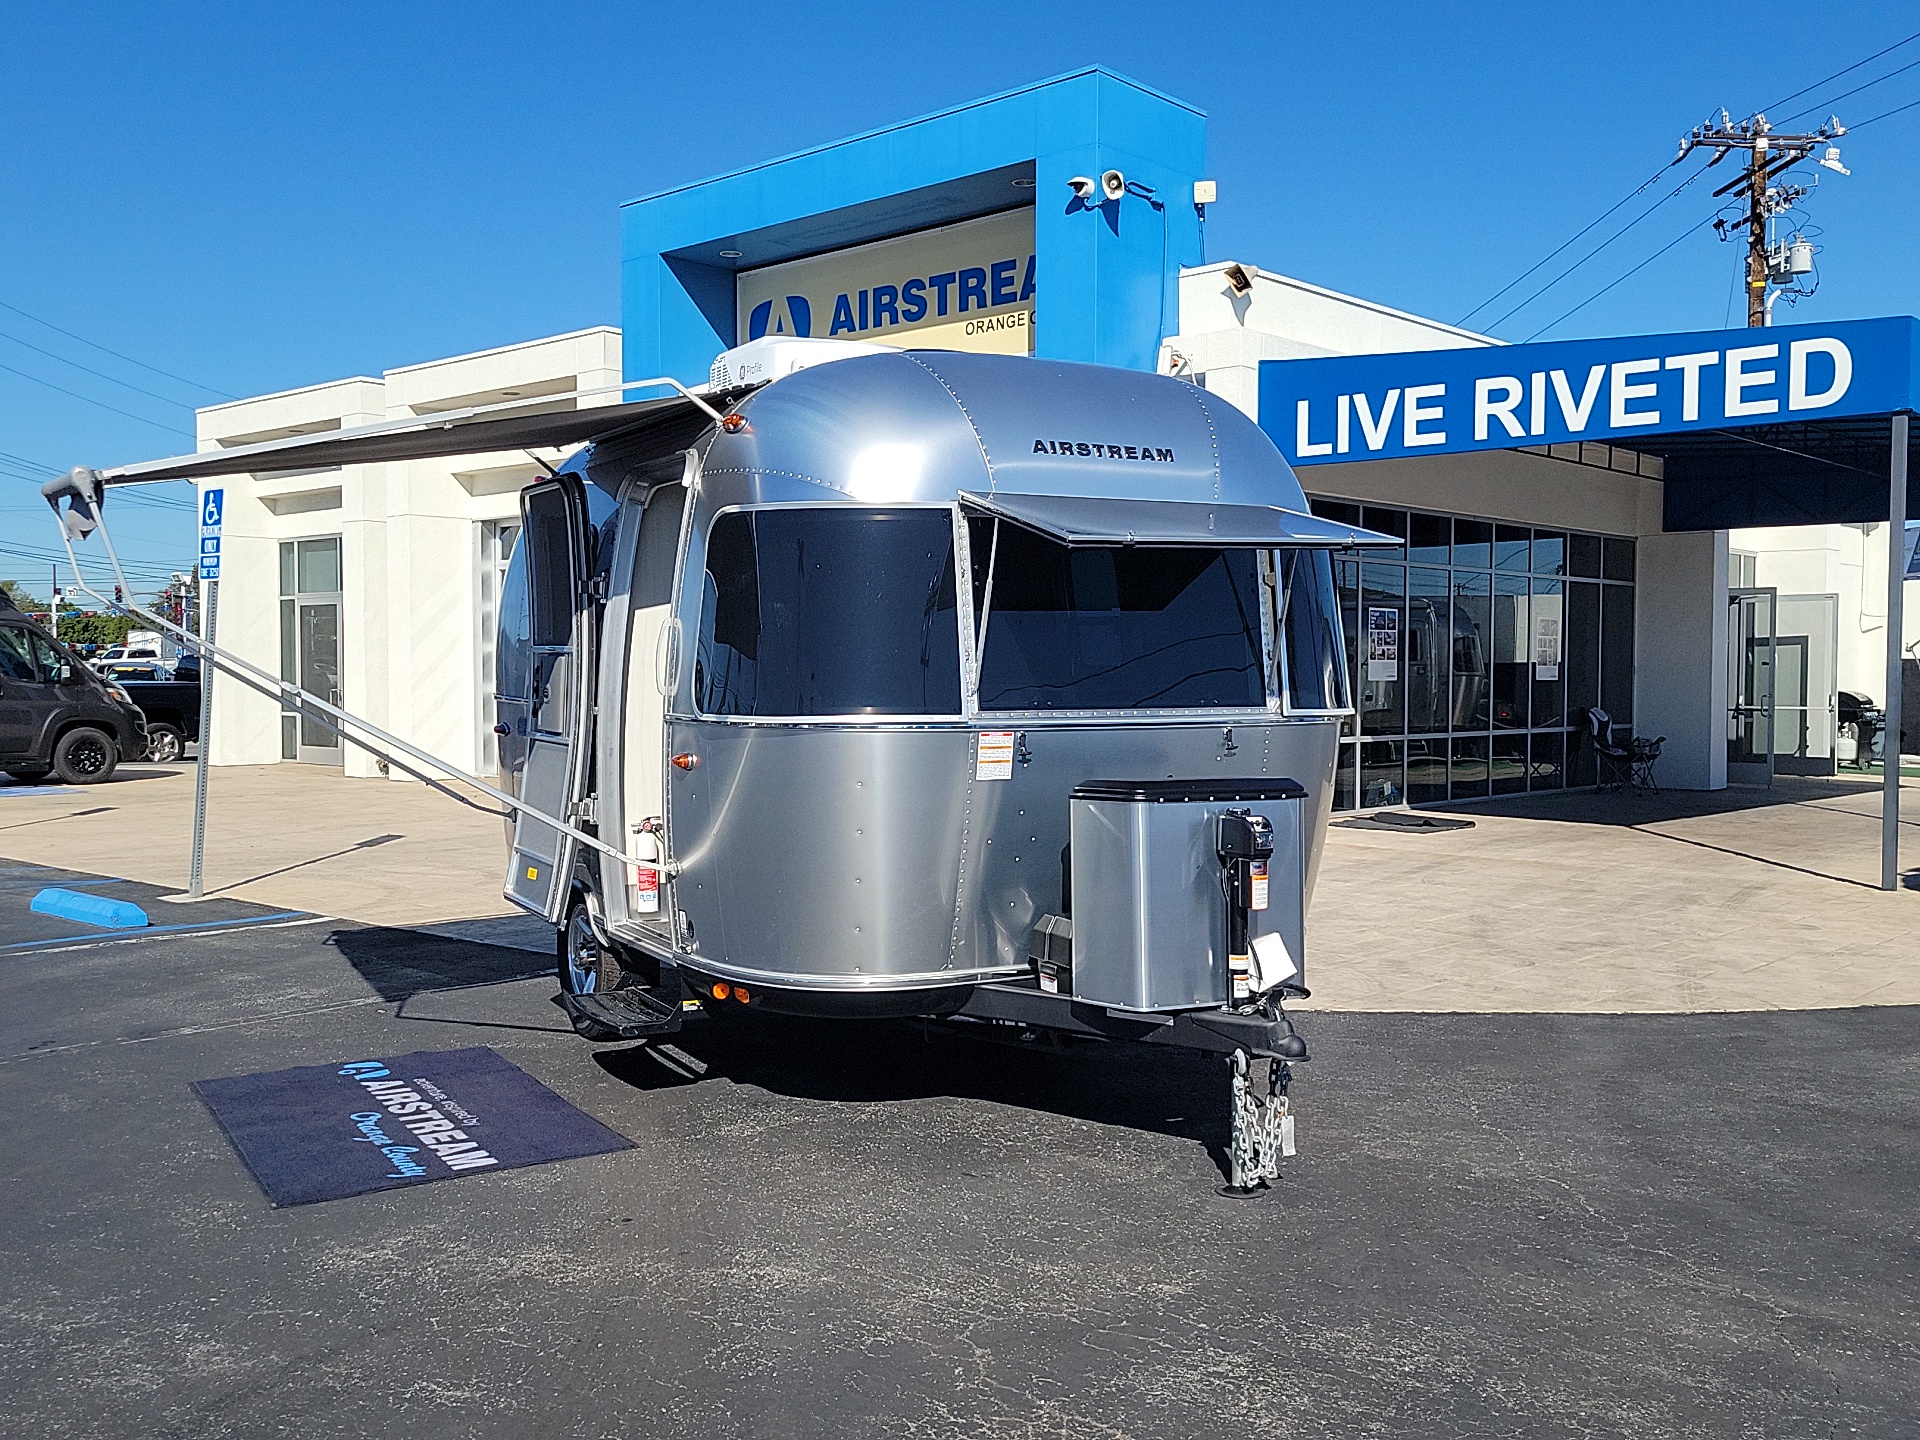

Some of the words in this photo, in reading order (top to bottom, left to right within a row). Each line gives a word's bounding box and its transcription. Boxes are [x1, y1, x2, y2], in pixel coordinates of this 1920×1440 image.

[965, 312, 1025, 335] ORANGE
[746, 362, 763, 375] Profile
[1295, 383, 1446, 458] LIVE
[1474, 337, 1854, 441] RIVETED
[1032, 439, 1175, 463] AIRSTREAM
[350, 1111, 394, 1146] Orange
[380, 1145, 428, 1179] County
[360, 1080, 499, 1171] AIRSTREAM
